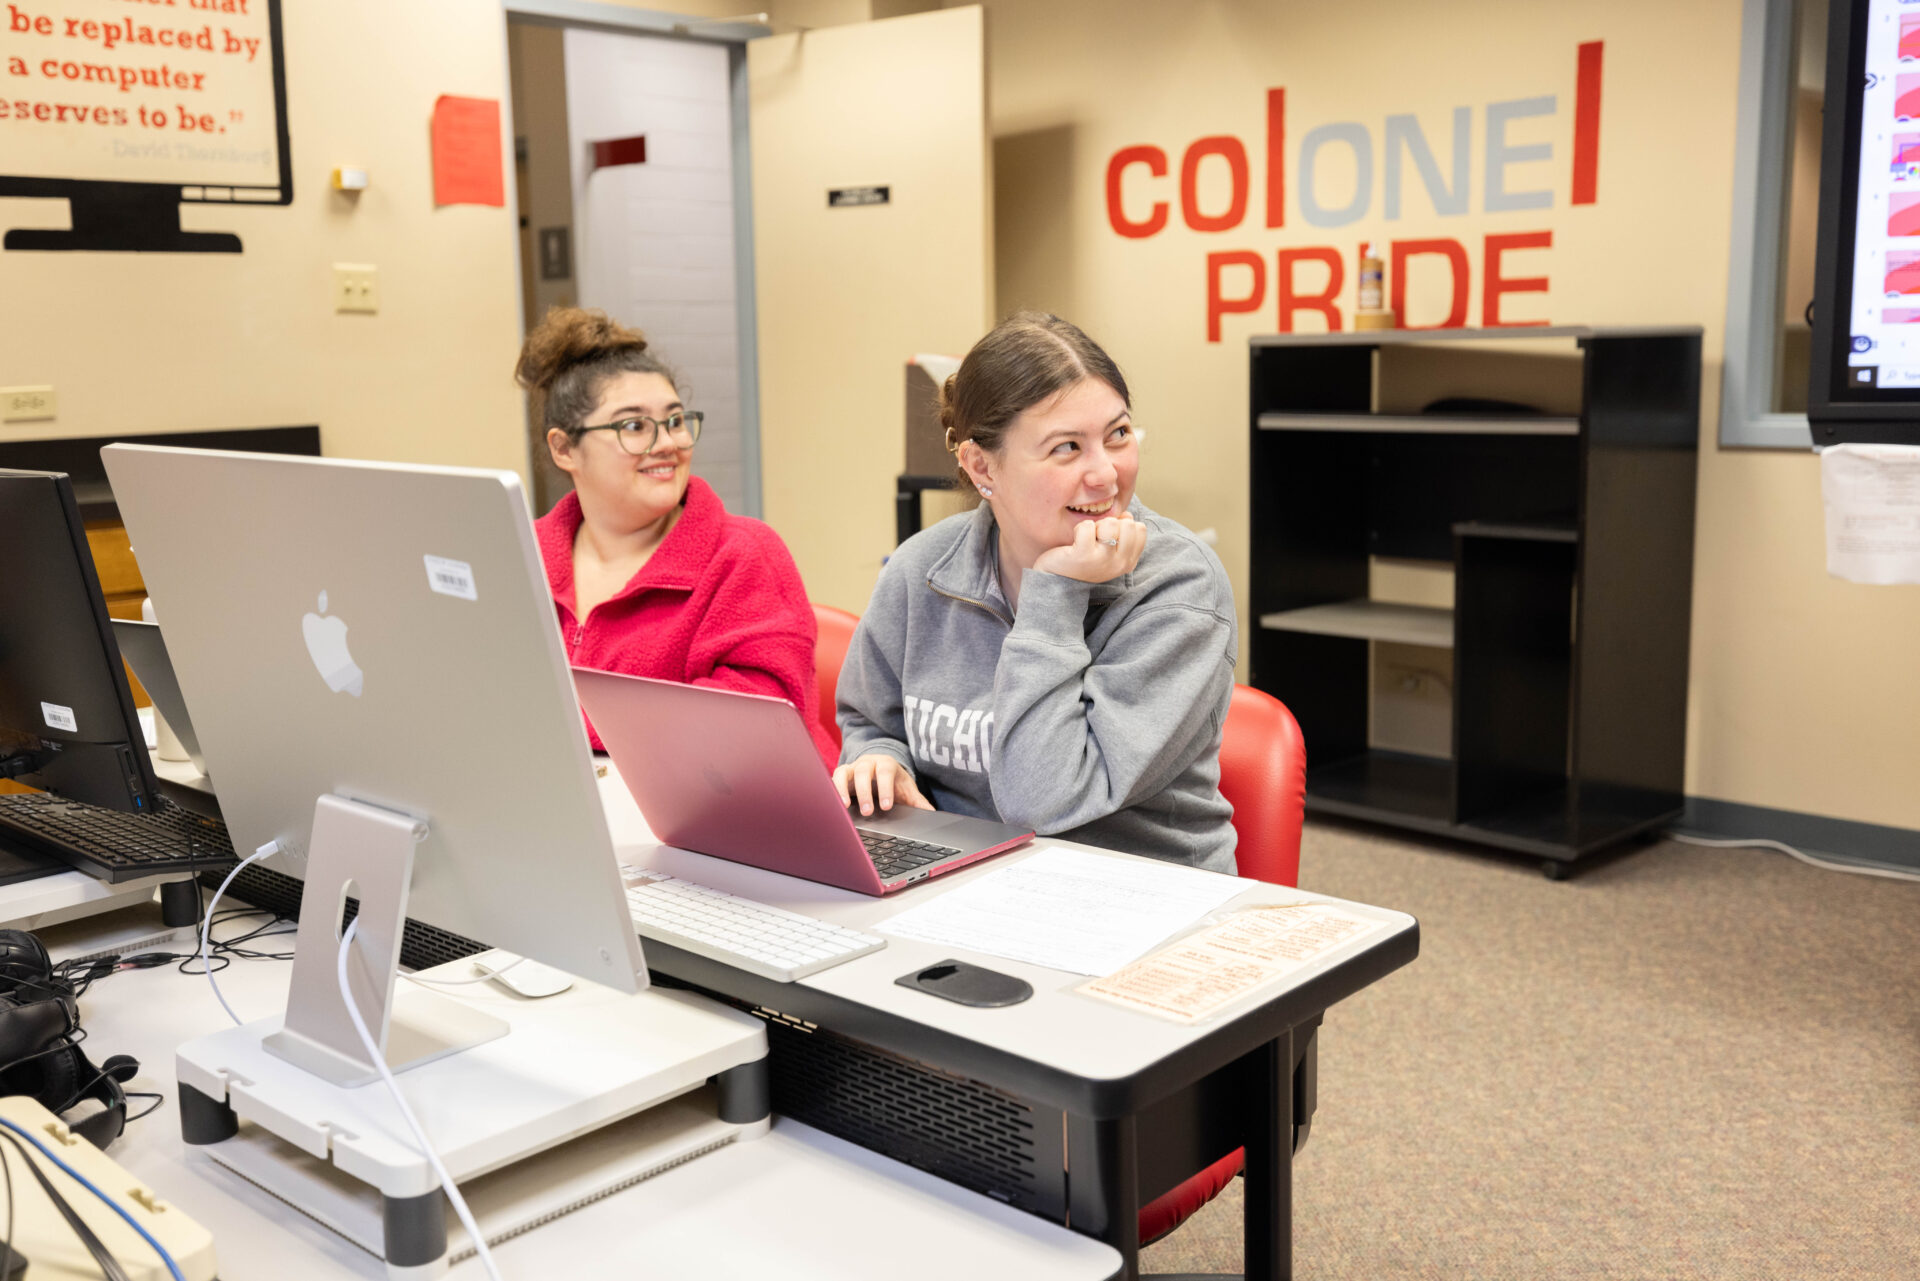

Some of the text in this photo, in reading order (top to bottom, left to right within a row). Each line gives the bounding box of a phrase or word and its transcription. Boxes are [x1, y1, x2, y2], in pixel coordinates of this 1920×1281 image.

[8, 5, 261, 62] be replaced by
[9, 56, 206, 91] a computer
[138, 104, 168, 129] to
